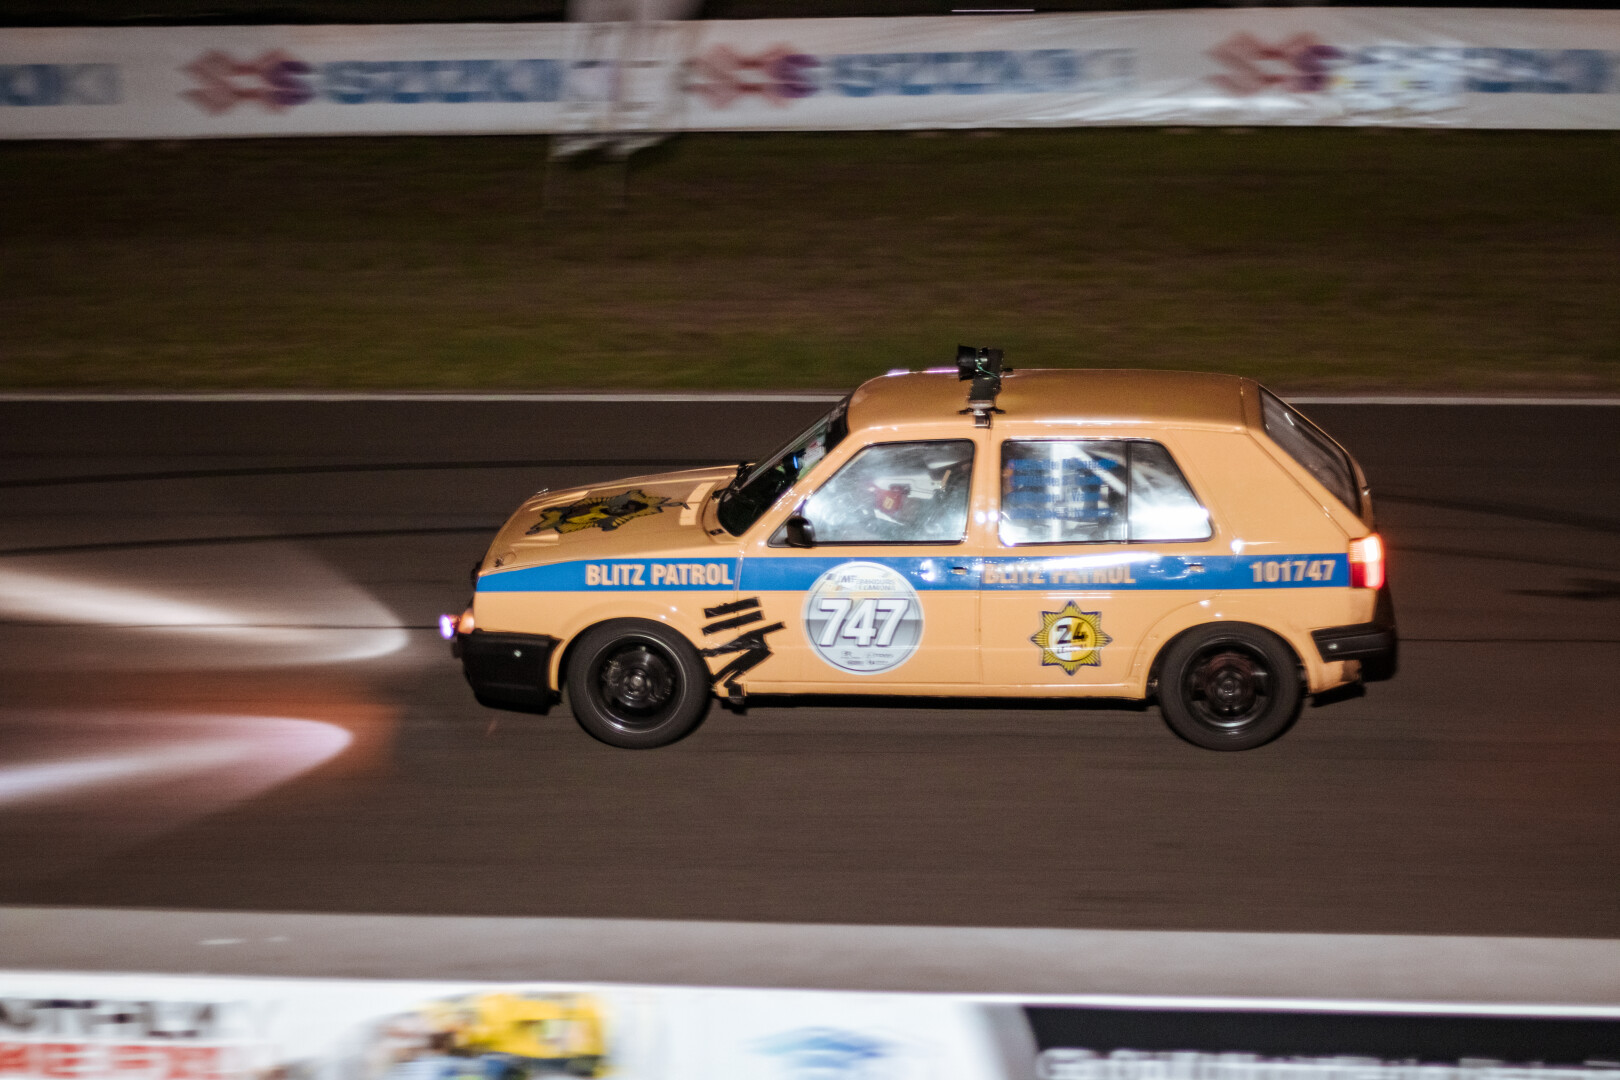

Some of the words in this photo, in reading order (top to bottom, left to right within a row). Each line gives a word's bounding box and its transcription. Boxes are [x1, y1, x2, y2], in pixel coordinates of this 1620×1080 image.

[585, 564, 646, 586] BLITZ
[651, 563, 734, 585] PATROL
[1249, 559, 1337, 583] 101747
[818, 597, 911, 648] 747
[1055, 621, 1090, 645] 24
